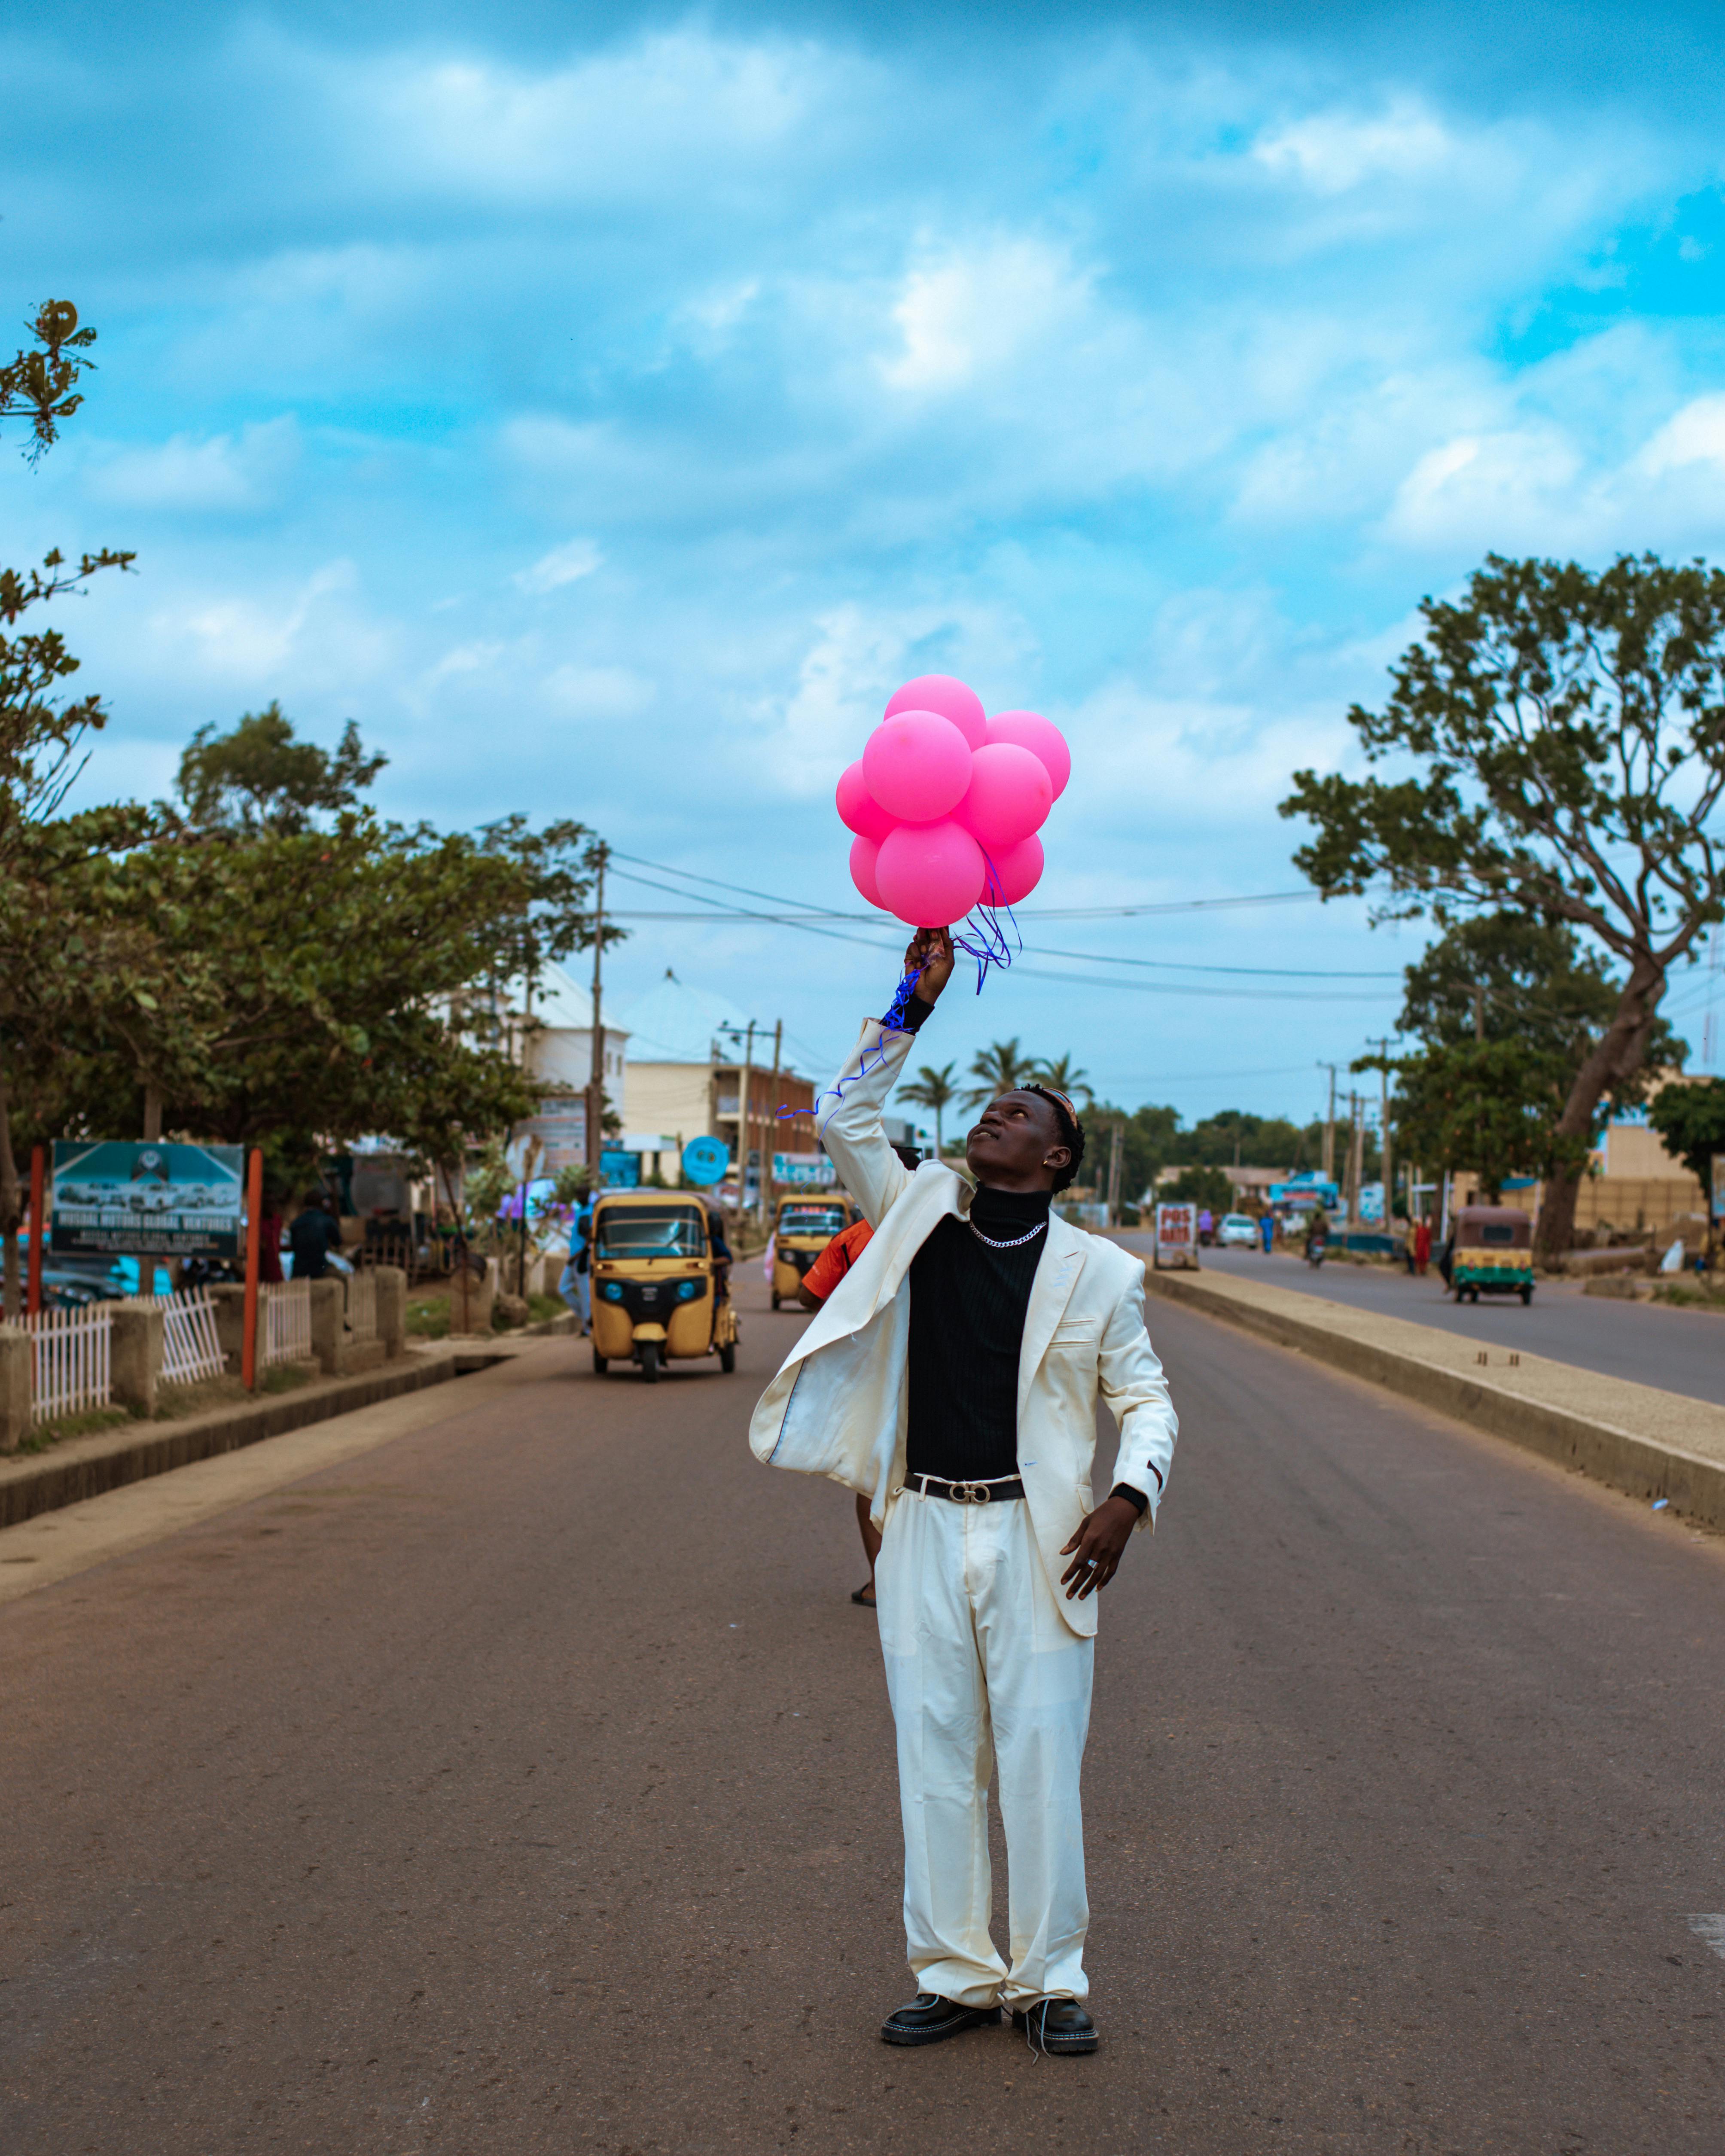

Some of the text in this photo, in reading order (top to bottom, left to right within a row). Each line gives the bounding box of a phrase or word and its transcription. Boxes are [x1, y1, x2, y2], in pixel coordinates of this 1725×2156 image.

[101, 1212, 141, 1228] MOTORS
[143, 1214, 179, 1229] GLOBAL
[183, 1215, 233, 1231] VENTURES
[1161, 1209, 1191, 1225] POS
